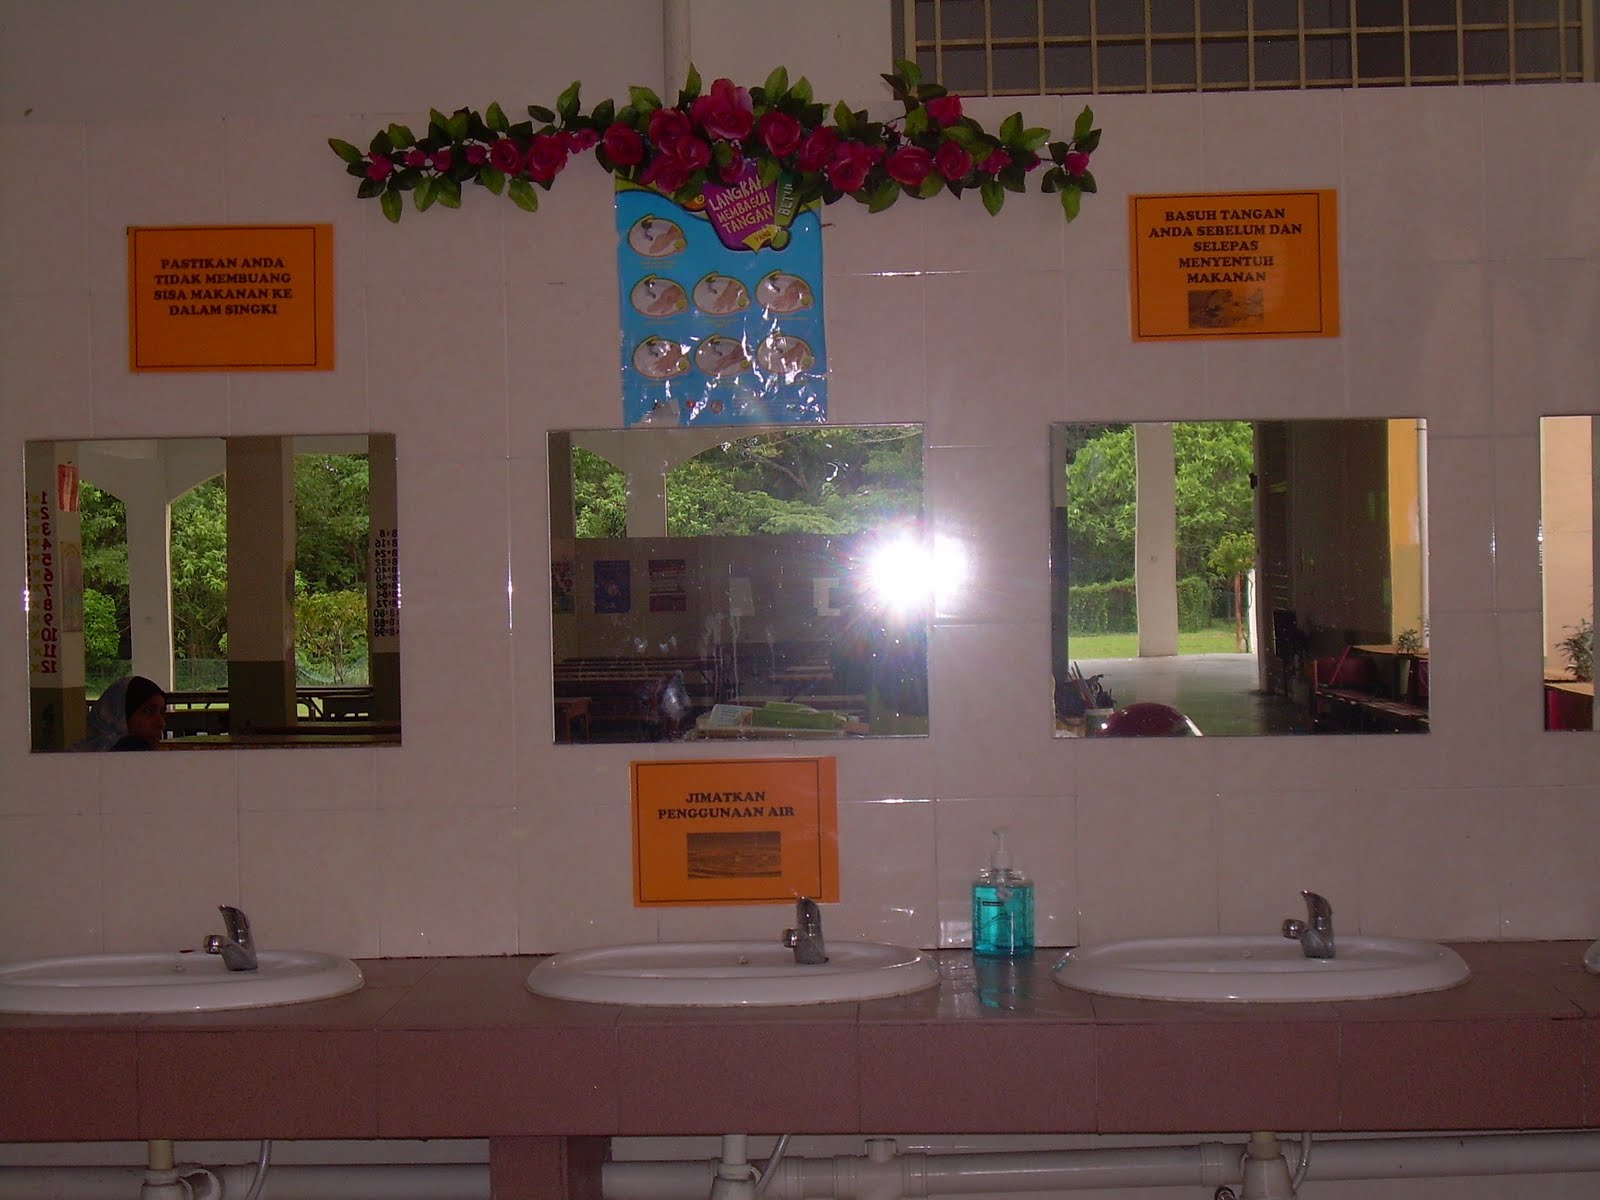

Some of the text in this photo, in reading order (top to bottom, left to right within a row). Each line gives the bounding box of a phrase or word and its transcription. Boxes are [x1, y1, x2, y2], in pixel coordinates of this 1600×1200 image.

[716, 190, 770, 223] MEMBASUH
[722, 204, 774, 234] TANGAN
[1164, 208, 1286, 222] BASUH TANGAN
[1148, 223, 1303, 238] ANDA SEBELUM DAN
[1193, 240, 1259, 252] SELEPAS
[160, 257, 285, 269] PASTIKAN ANDA
[1178, 256, 1275, 268] MENYENTUH
[154, 272, 291, 285] TIDAK MEMBUANG
[1186, 271, 1267, 284] MAKANAN
[153, 288, 293, 301] SISA MAKANAN KE
[168, 304, 278, 316] DALAM SINGKI
[684, 791, 766, 803] JIMATKAN
[657, 805, 796, 820] PENGGUNAAN AIR
